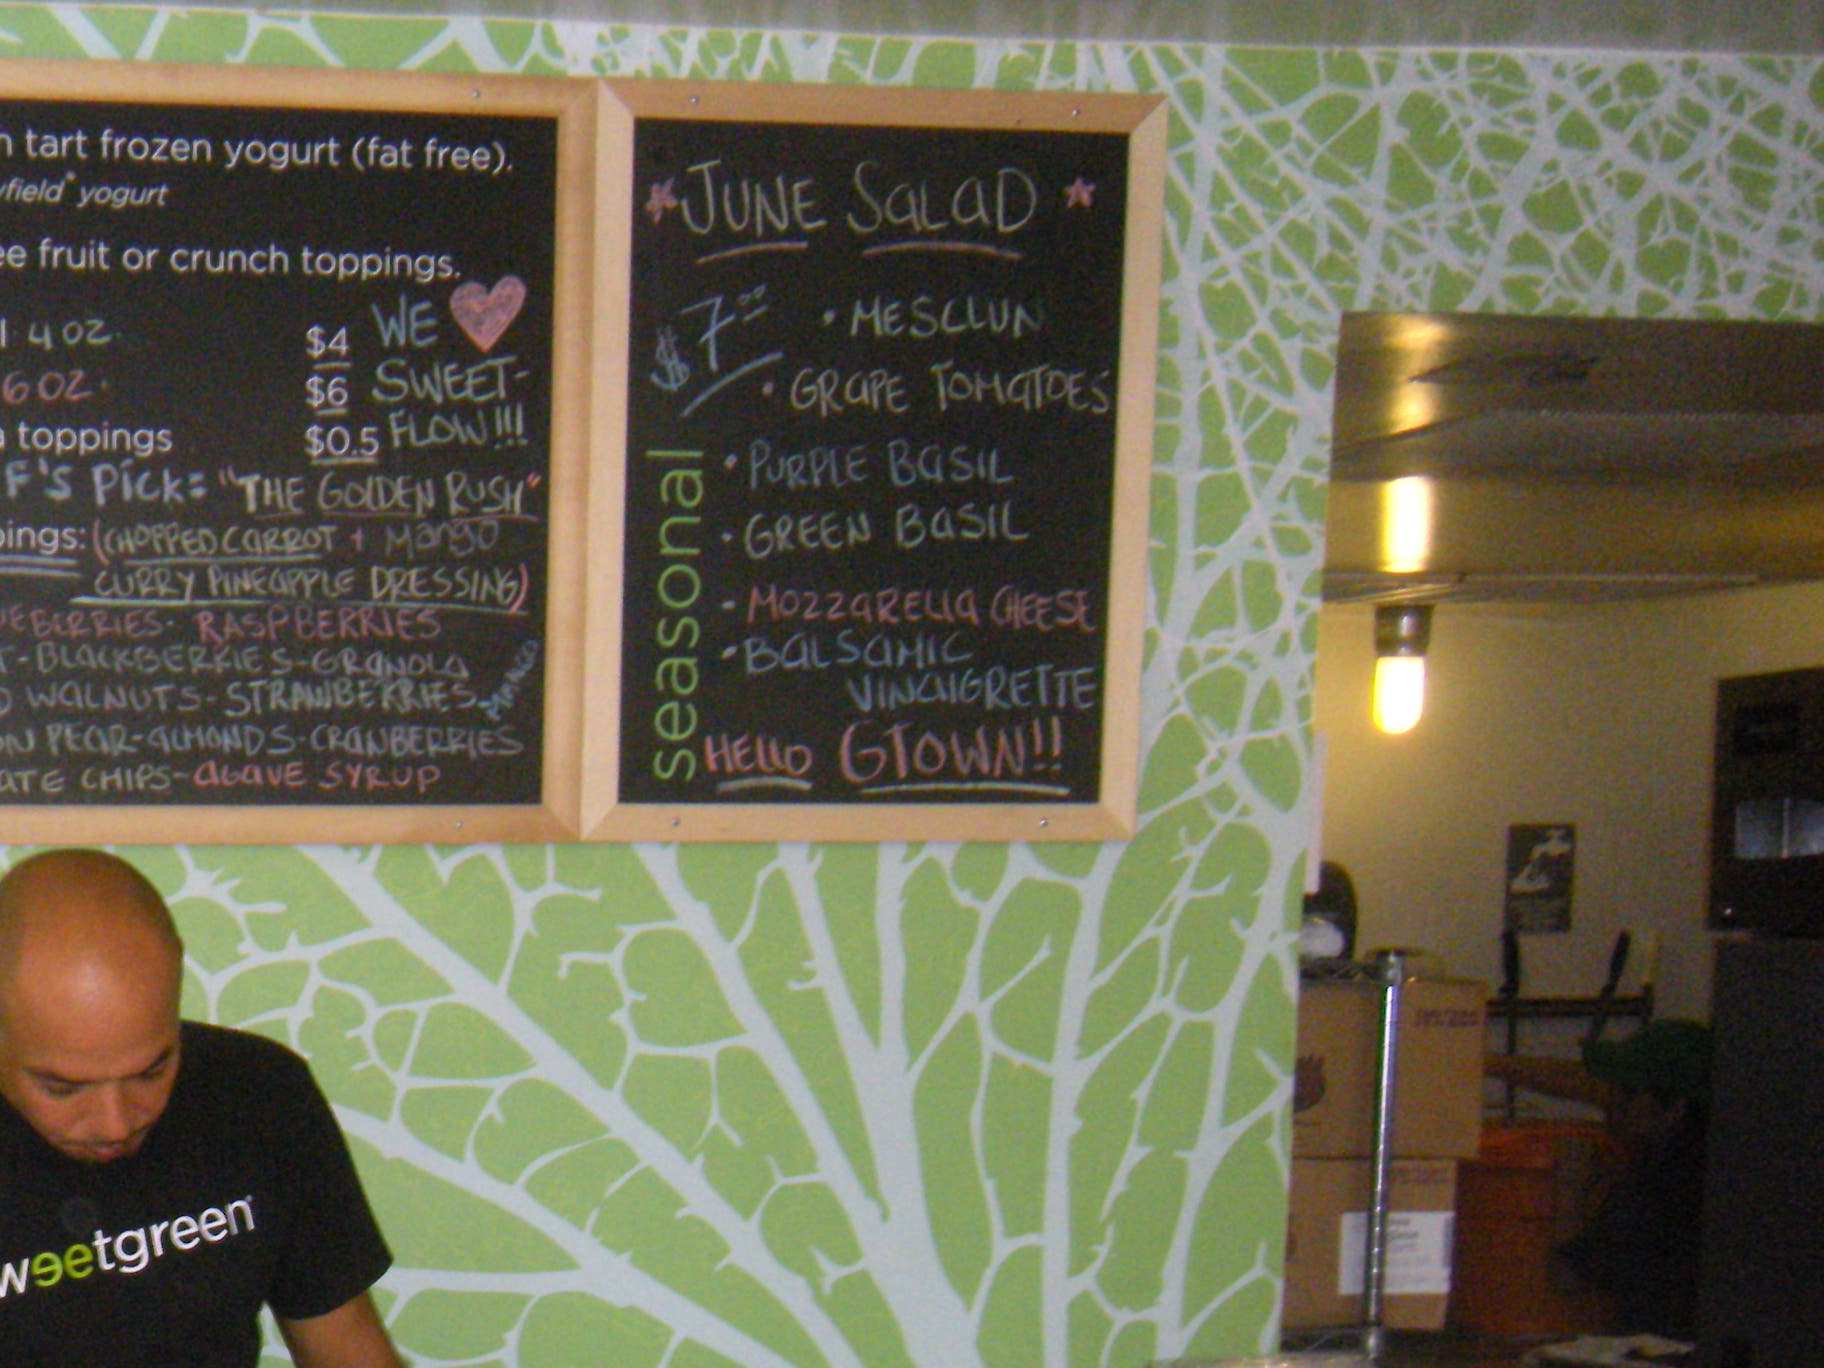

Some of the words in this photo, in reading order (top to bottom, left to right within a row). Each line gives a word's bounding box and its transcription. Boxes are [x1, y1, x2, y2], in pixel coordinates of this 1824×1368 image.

[25, 127, 88, 159] tart
[100, 128, 213, 162] frozen
[224, 137, 340, 169] yogurt
[351, 136, 413, 172] (fat
[424, 137, 513, 175] free).
[76, 182, 170, 208] yogurt
[681, 160, 826, 235] JUNE
[39, 237, 110, 270] fruit
[122, 246, 160, 272] or
[170, 244, 289, 274] crunch
[302, 246, 462, 283] toppings.
[371, 294, 438, 348] WE
[851, 296, 1042, 338] MESCLUN
[305, 325, 350, 359] $4
[305, 375, 349, 407] $6
[18, 422, 173, 456] toppings
[305, 425, 380, 458] $0.5
[749, 441, 869, 490] PURPLE
[317, 472, 436, 511] GOLDEN
[745, 513, 872, 560] GREEN
[646, 449, 704, 782] seasonal
[705, 734, 813, 776] HELLO
[318, 763, 442, 793] SYRUP
